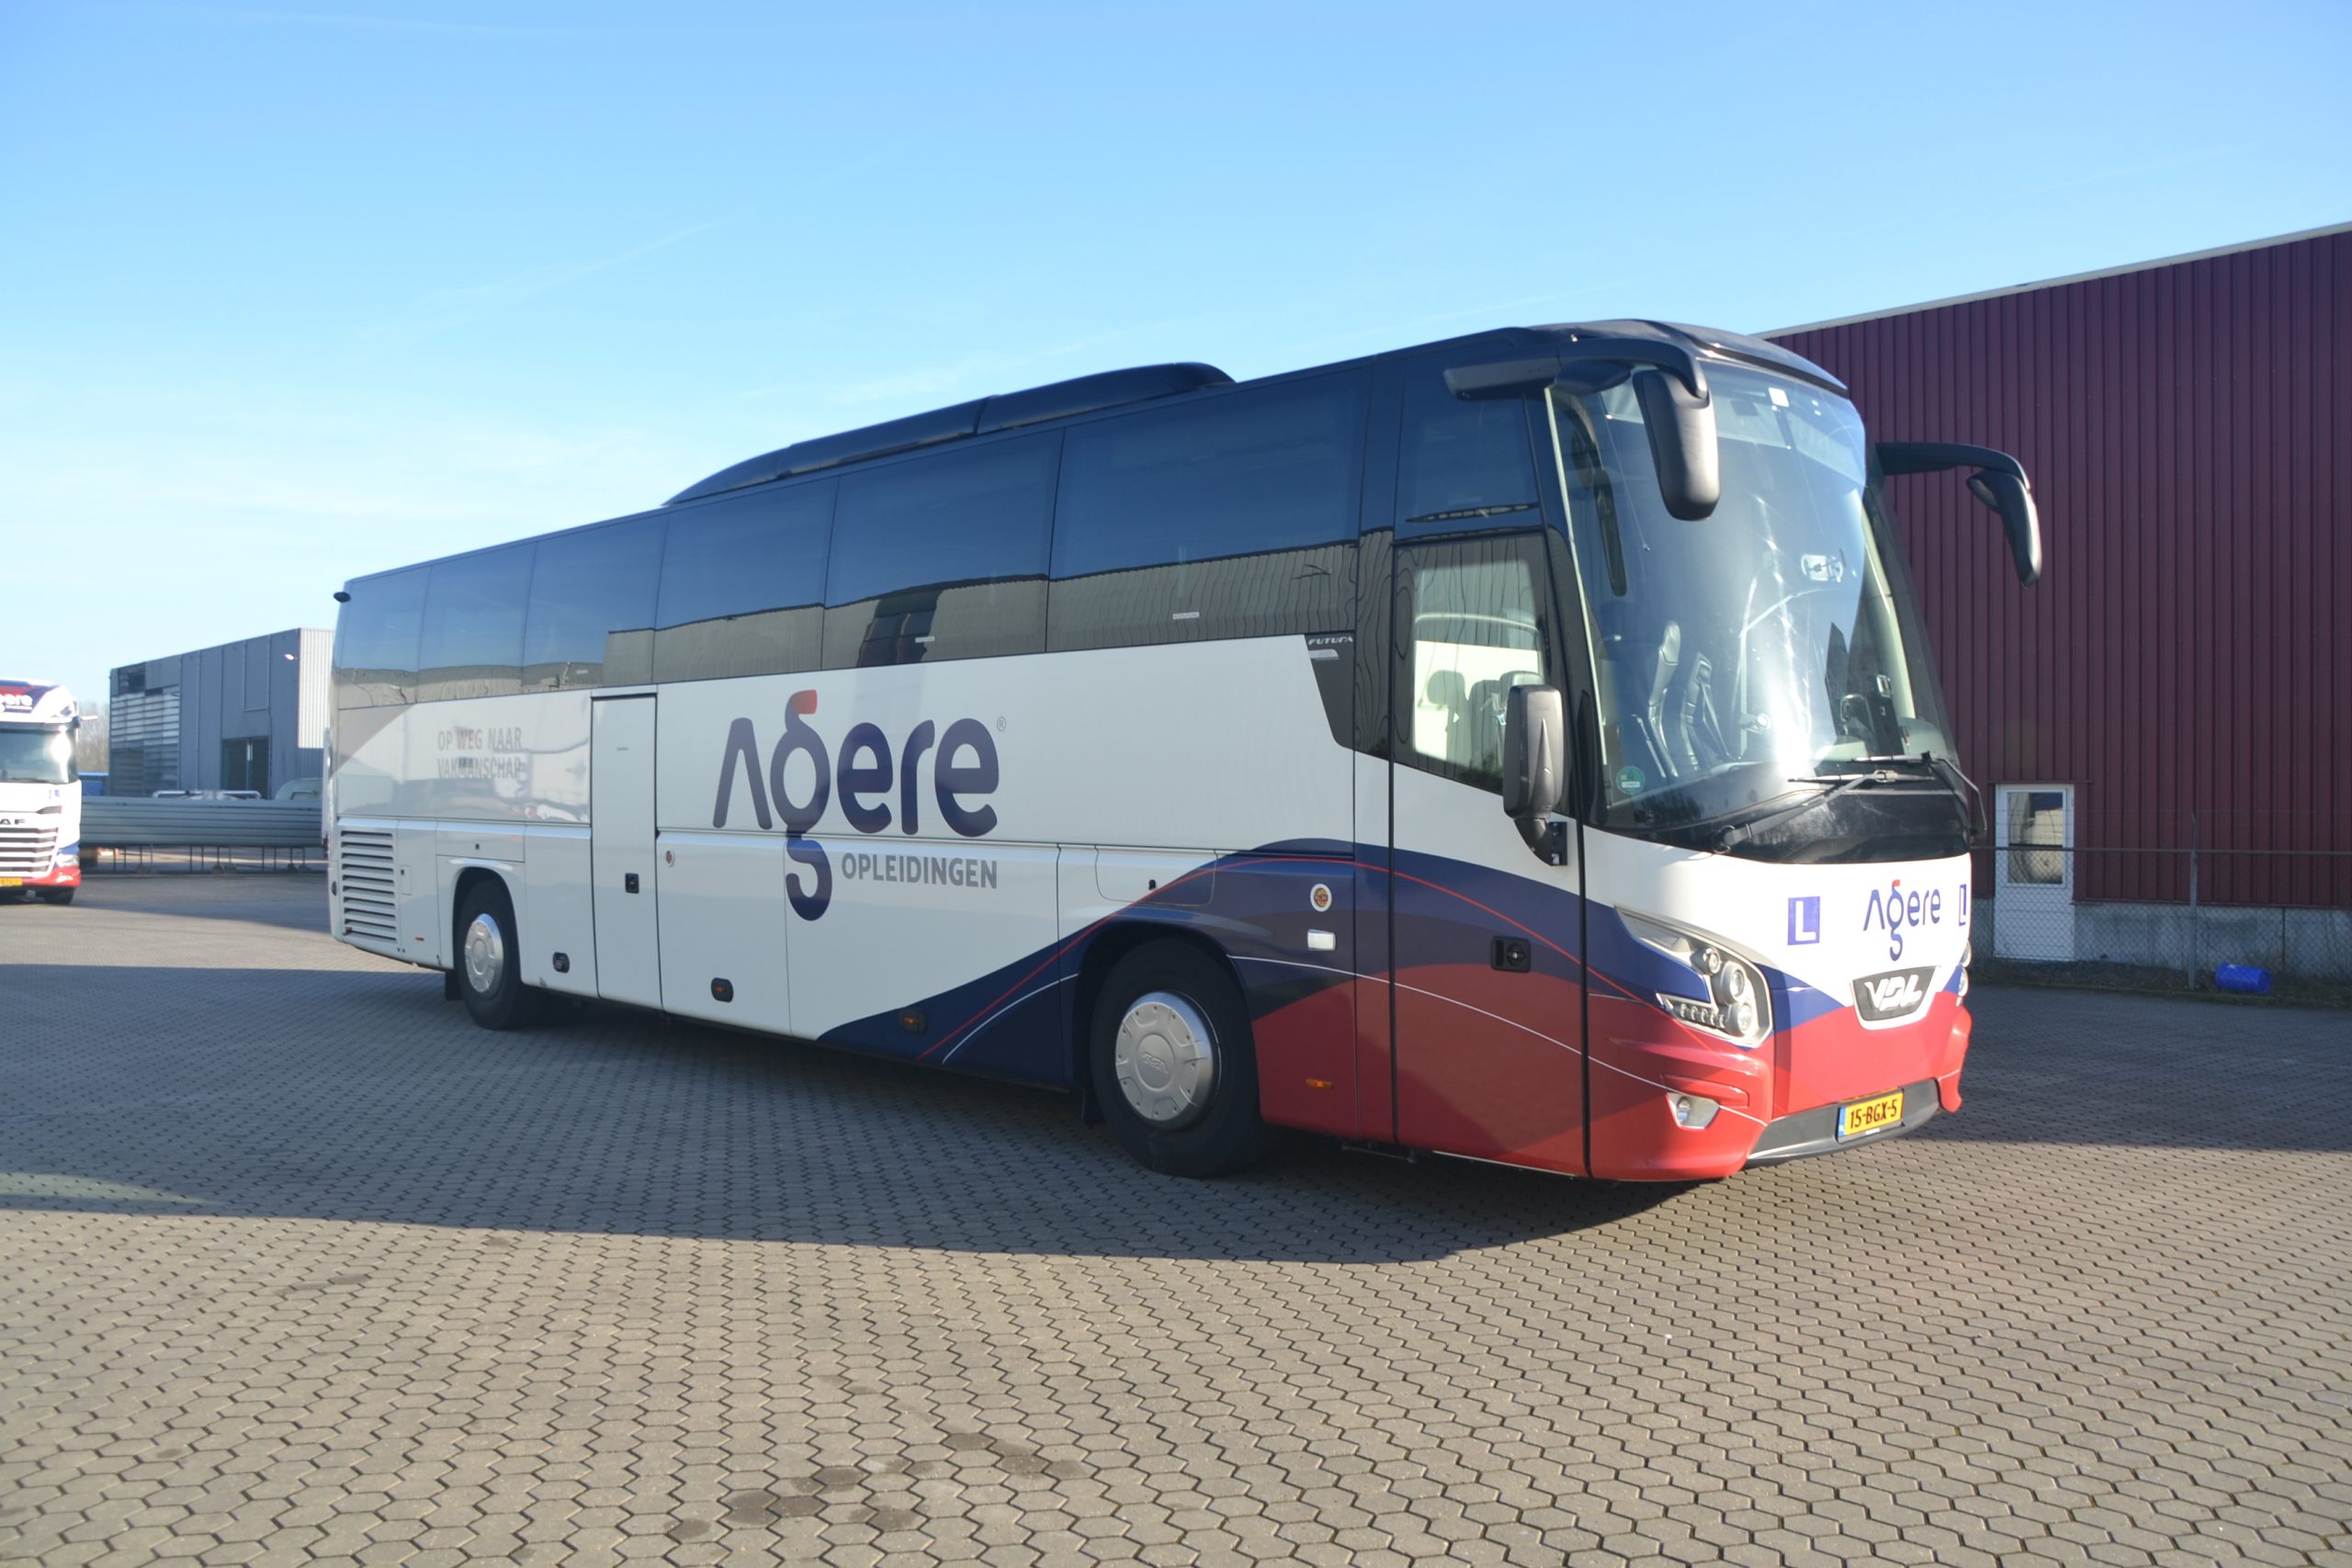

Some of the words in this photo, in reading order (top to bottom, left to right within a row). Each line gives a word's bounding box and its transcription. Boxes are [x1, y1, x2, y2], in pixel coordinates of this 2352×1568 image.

[1307, 636, 1353, 646] FUTURA
[437, 730, 453, 750] OP
[457, 728, 483, 750] WEG
[488, 727, 522, 750] NAAR
[436, 756, 522, 780] VAKMANSCHAP
[712, 689, 1000, 921] Agere
[842, 852, 998, 889] OPLEIDINGEN
[1794, 900, 1817, 942] L
[1863, 879, 1940, 962] Agere
[1863, 974, 1923, 1011] VDL
[1850, 1099, 1897, 1129] 15-BGX-5
